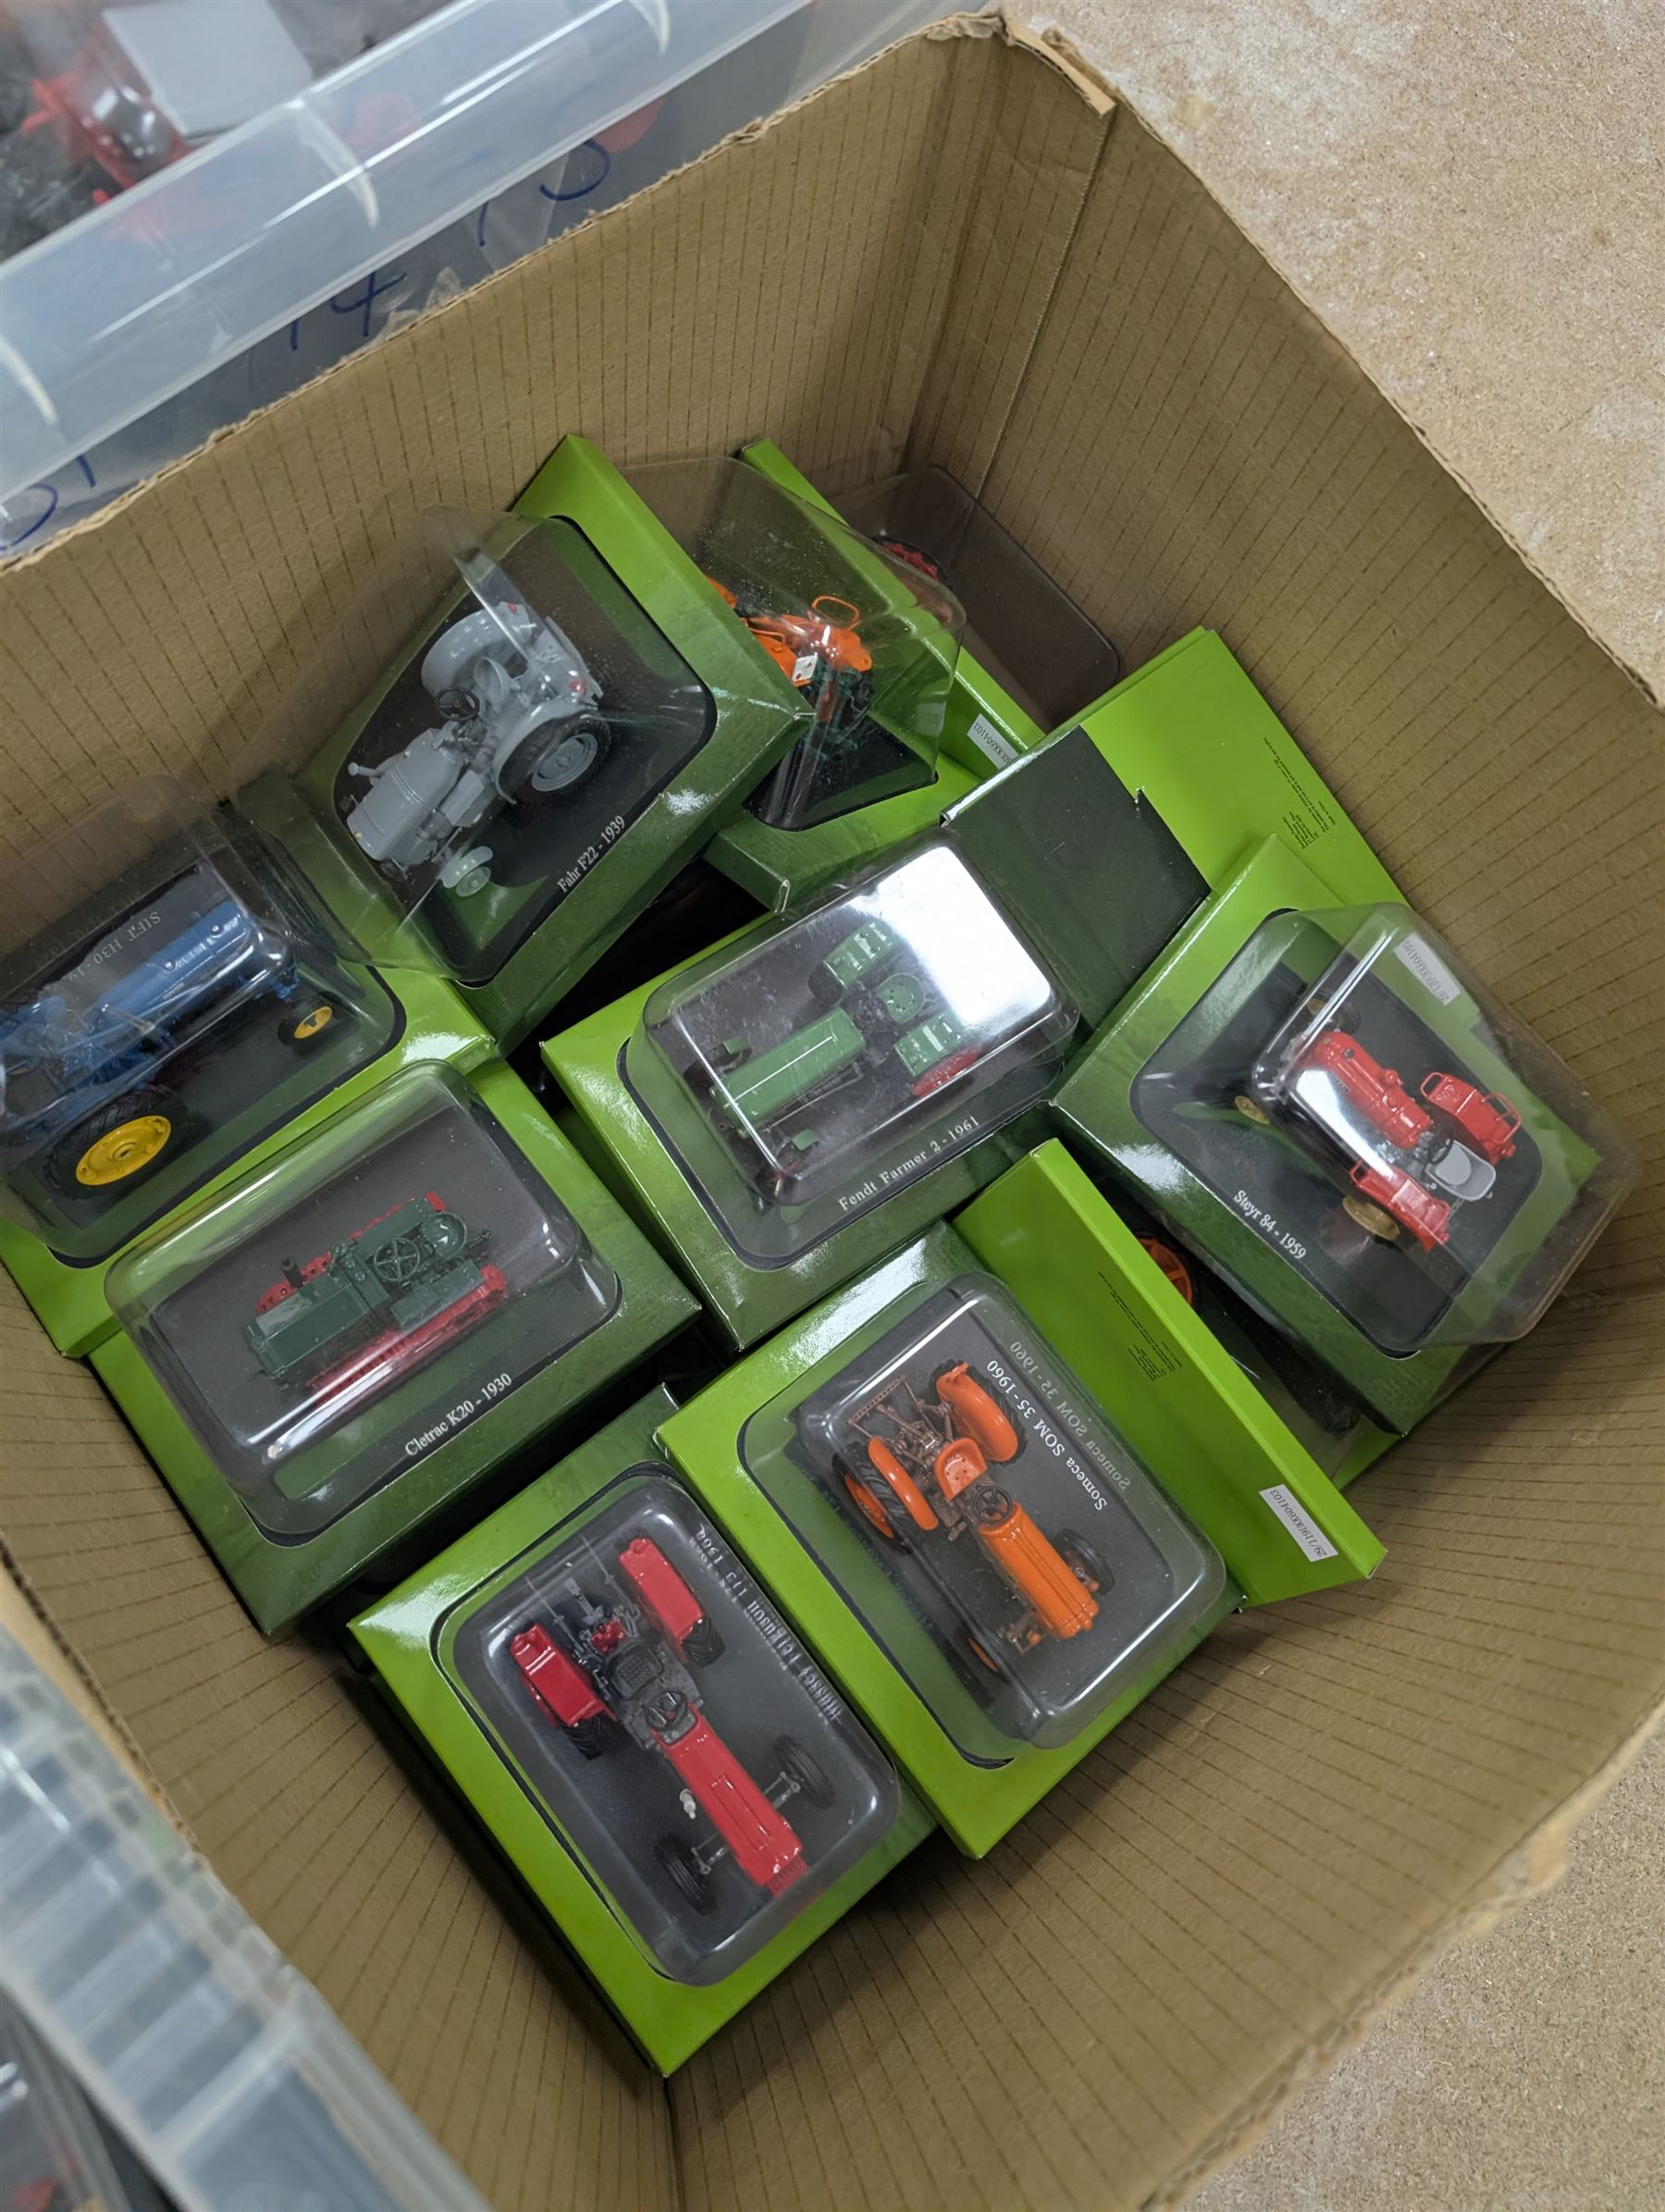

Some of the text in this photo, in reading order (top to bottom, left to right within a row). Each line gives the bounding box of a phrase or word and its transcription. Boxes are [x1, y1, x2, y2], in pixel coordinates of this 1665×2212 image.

[557, 867, 581, 893] Fahr
[577, 846, 598, 871] F22
[600, 815, 625, 844] 1939
[93, 939, 123, 964] H30
[128, 911, 161, 942] SIFT
[838, 1181, 878, 1211] Fendt
[880, 1151, 927, 1185] Farmer
[930, 1140, 942, 1153] 2
[948, 1116, 979, 1141] 1961
[1233, 1190, 1262, 1219] Steyr
[1259, 1214, 1276, 1232] 84
[1279, 1233, 1306, 1259] 1959
[405, 1421, 449, 1456] Cletrac
[446, 1400, 475, 1426] K20
[481, 1373, 512, 1401] 1930
[1032, 1419, 1066, 1456] SOM
[1066, 1457, 1107, 1511] Someca
